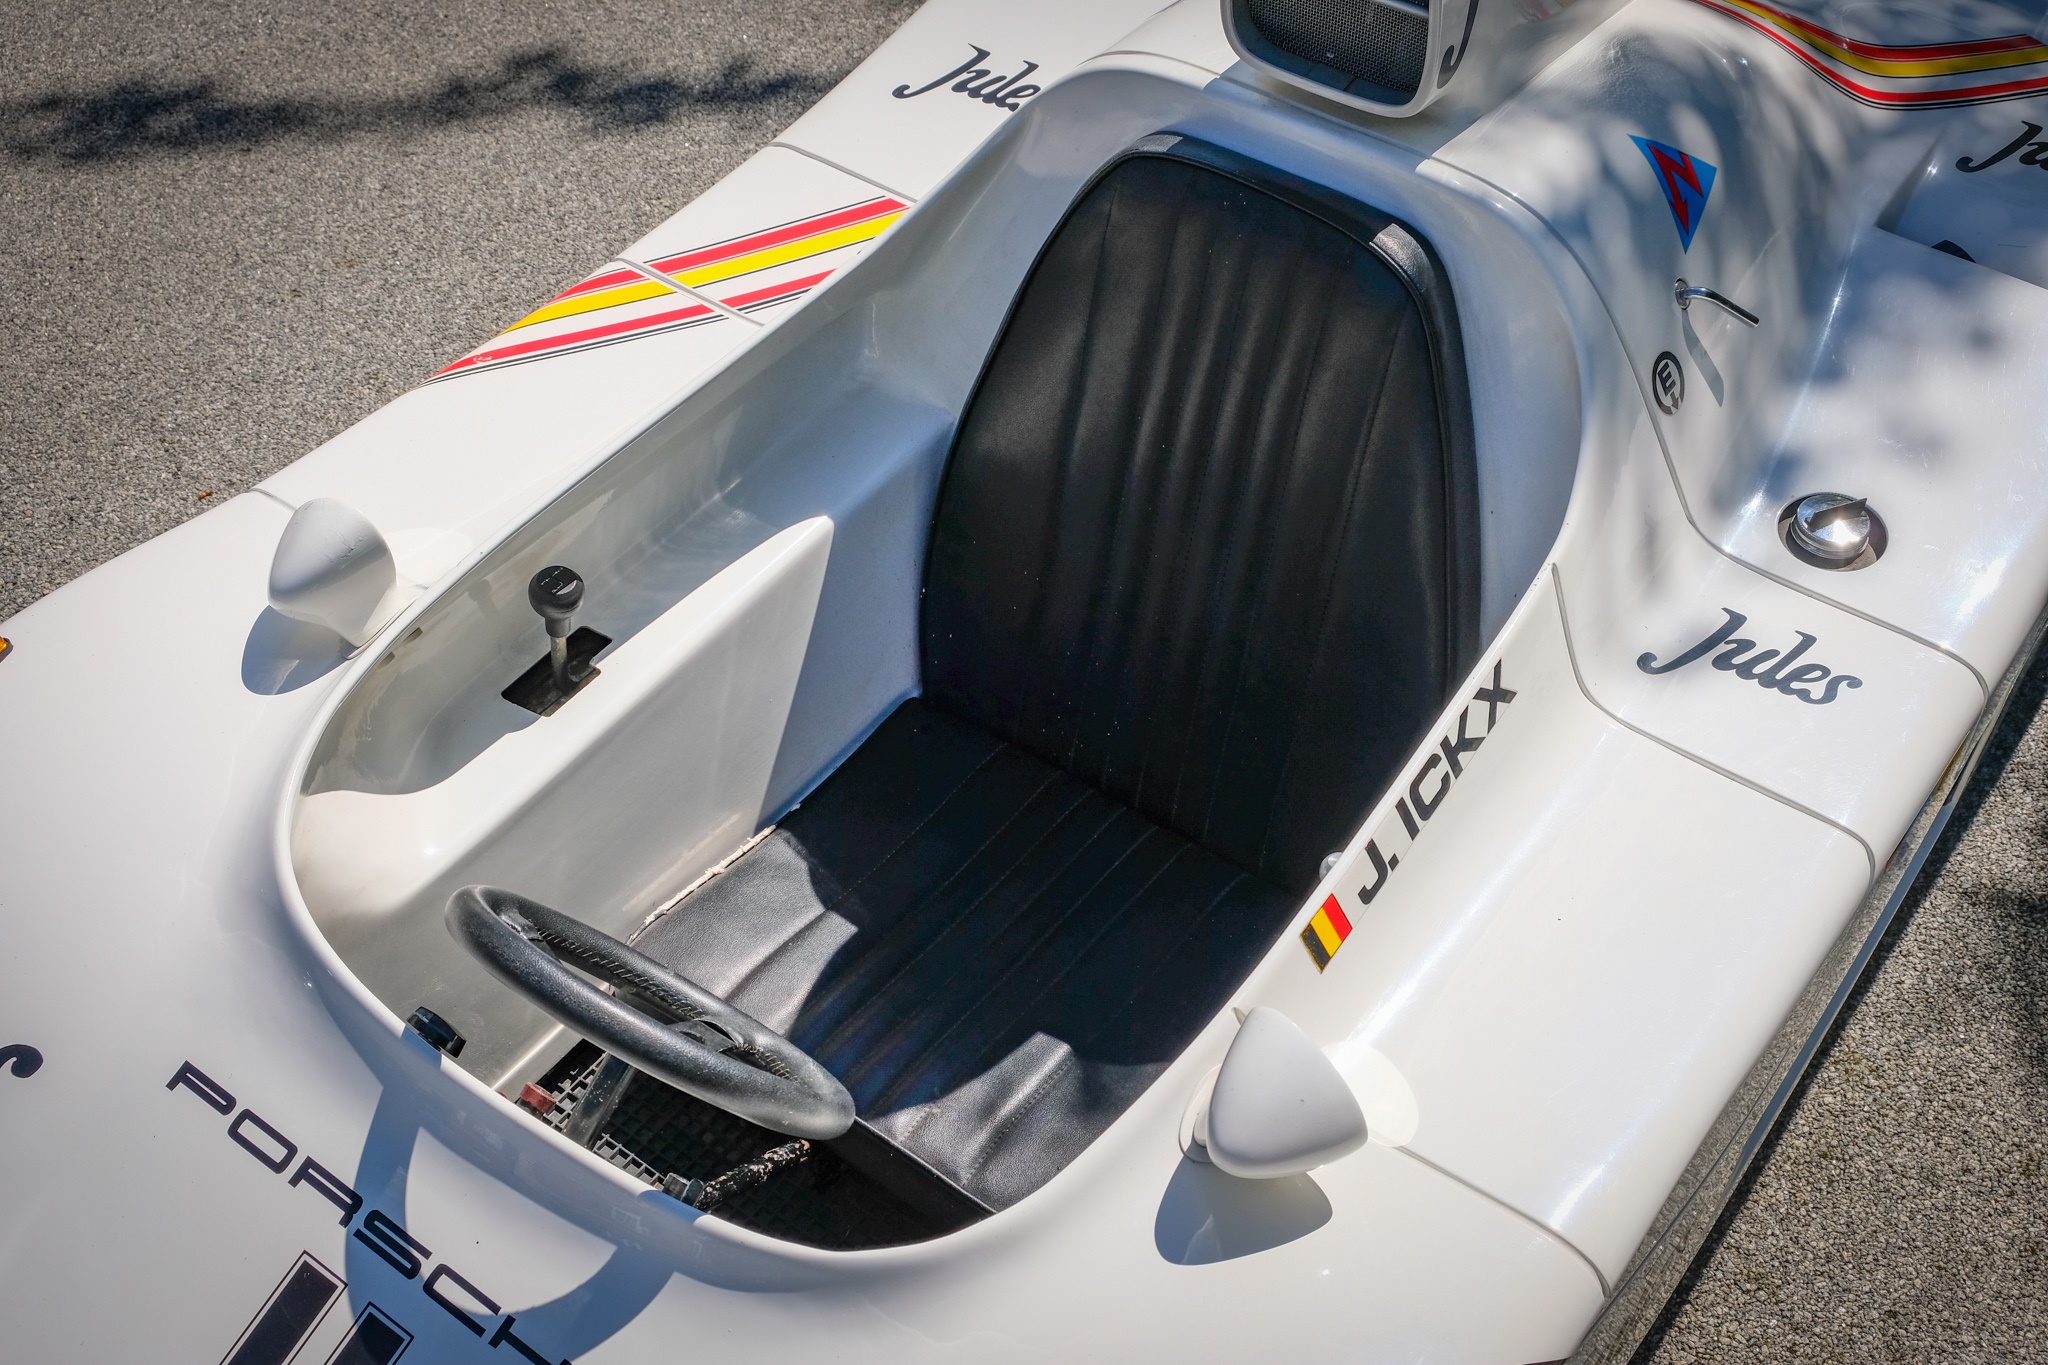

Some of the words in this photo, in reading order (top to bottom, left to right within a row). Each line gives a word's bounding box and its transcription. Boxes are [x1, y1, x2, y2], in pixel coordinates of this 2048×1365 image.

[891, 42, 1041, 112] Jule
[1636, 607, 1863, 705] Jules
[1357, 838, 1400, 905] J.
[1395, 657, 1518, 841] ICKX
